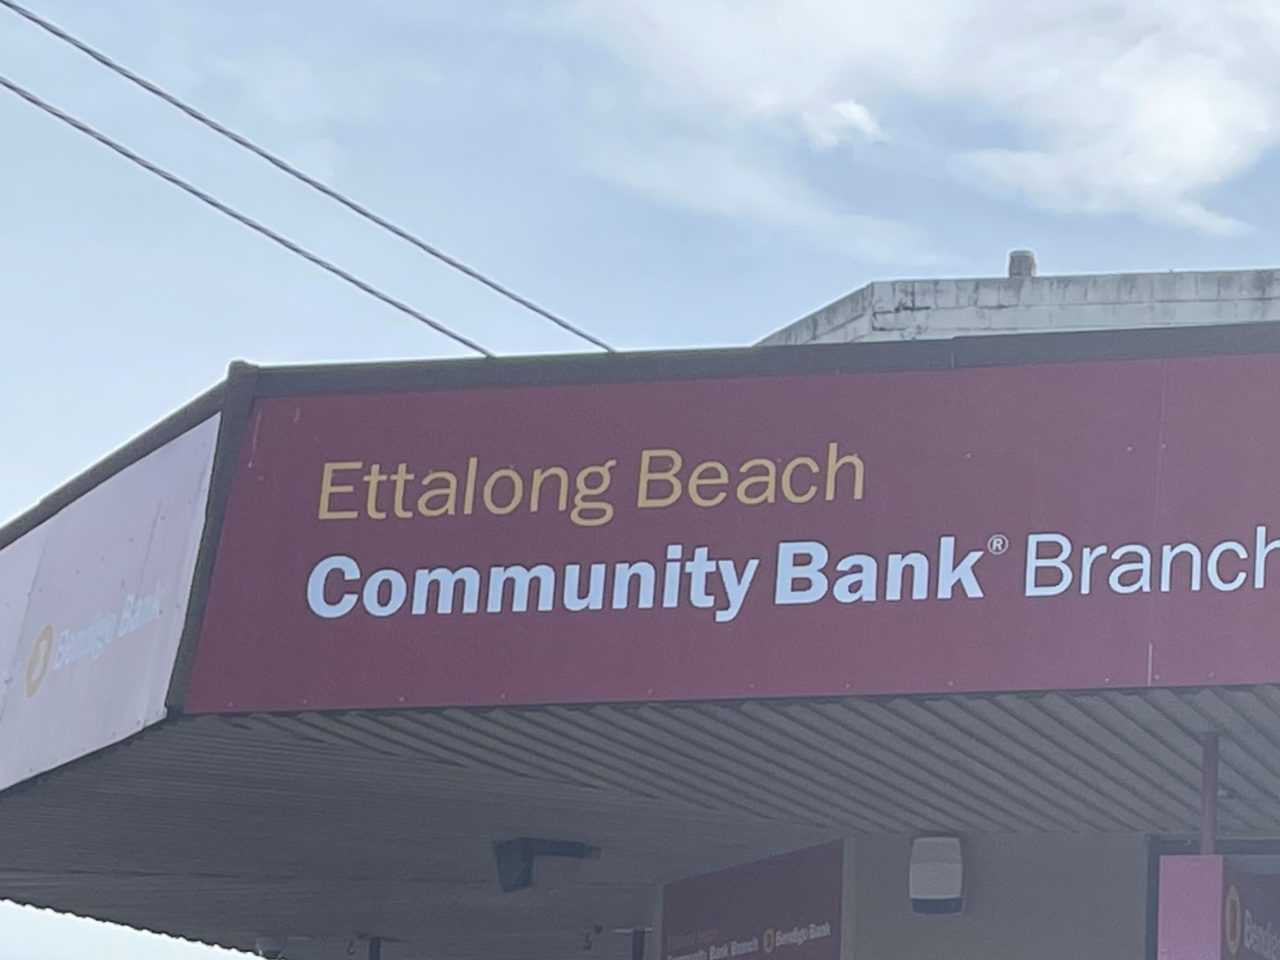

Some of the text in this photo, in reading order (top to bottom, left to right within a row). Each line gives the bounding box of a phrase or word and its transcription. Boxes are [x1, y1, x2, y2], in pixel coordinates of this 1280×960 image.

[318, 442, 865, 526] Ettalong Beach
[306, 544, 760, 623] Community
